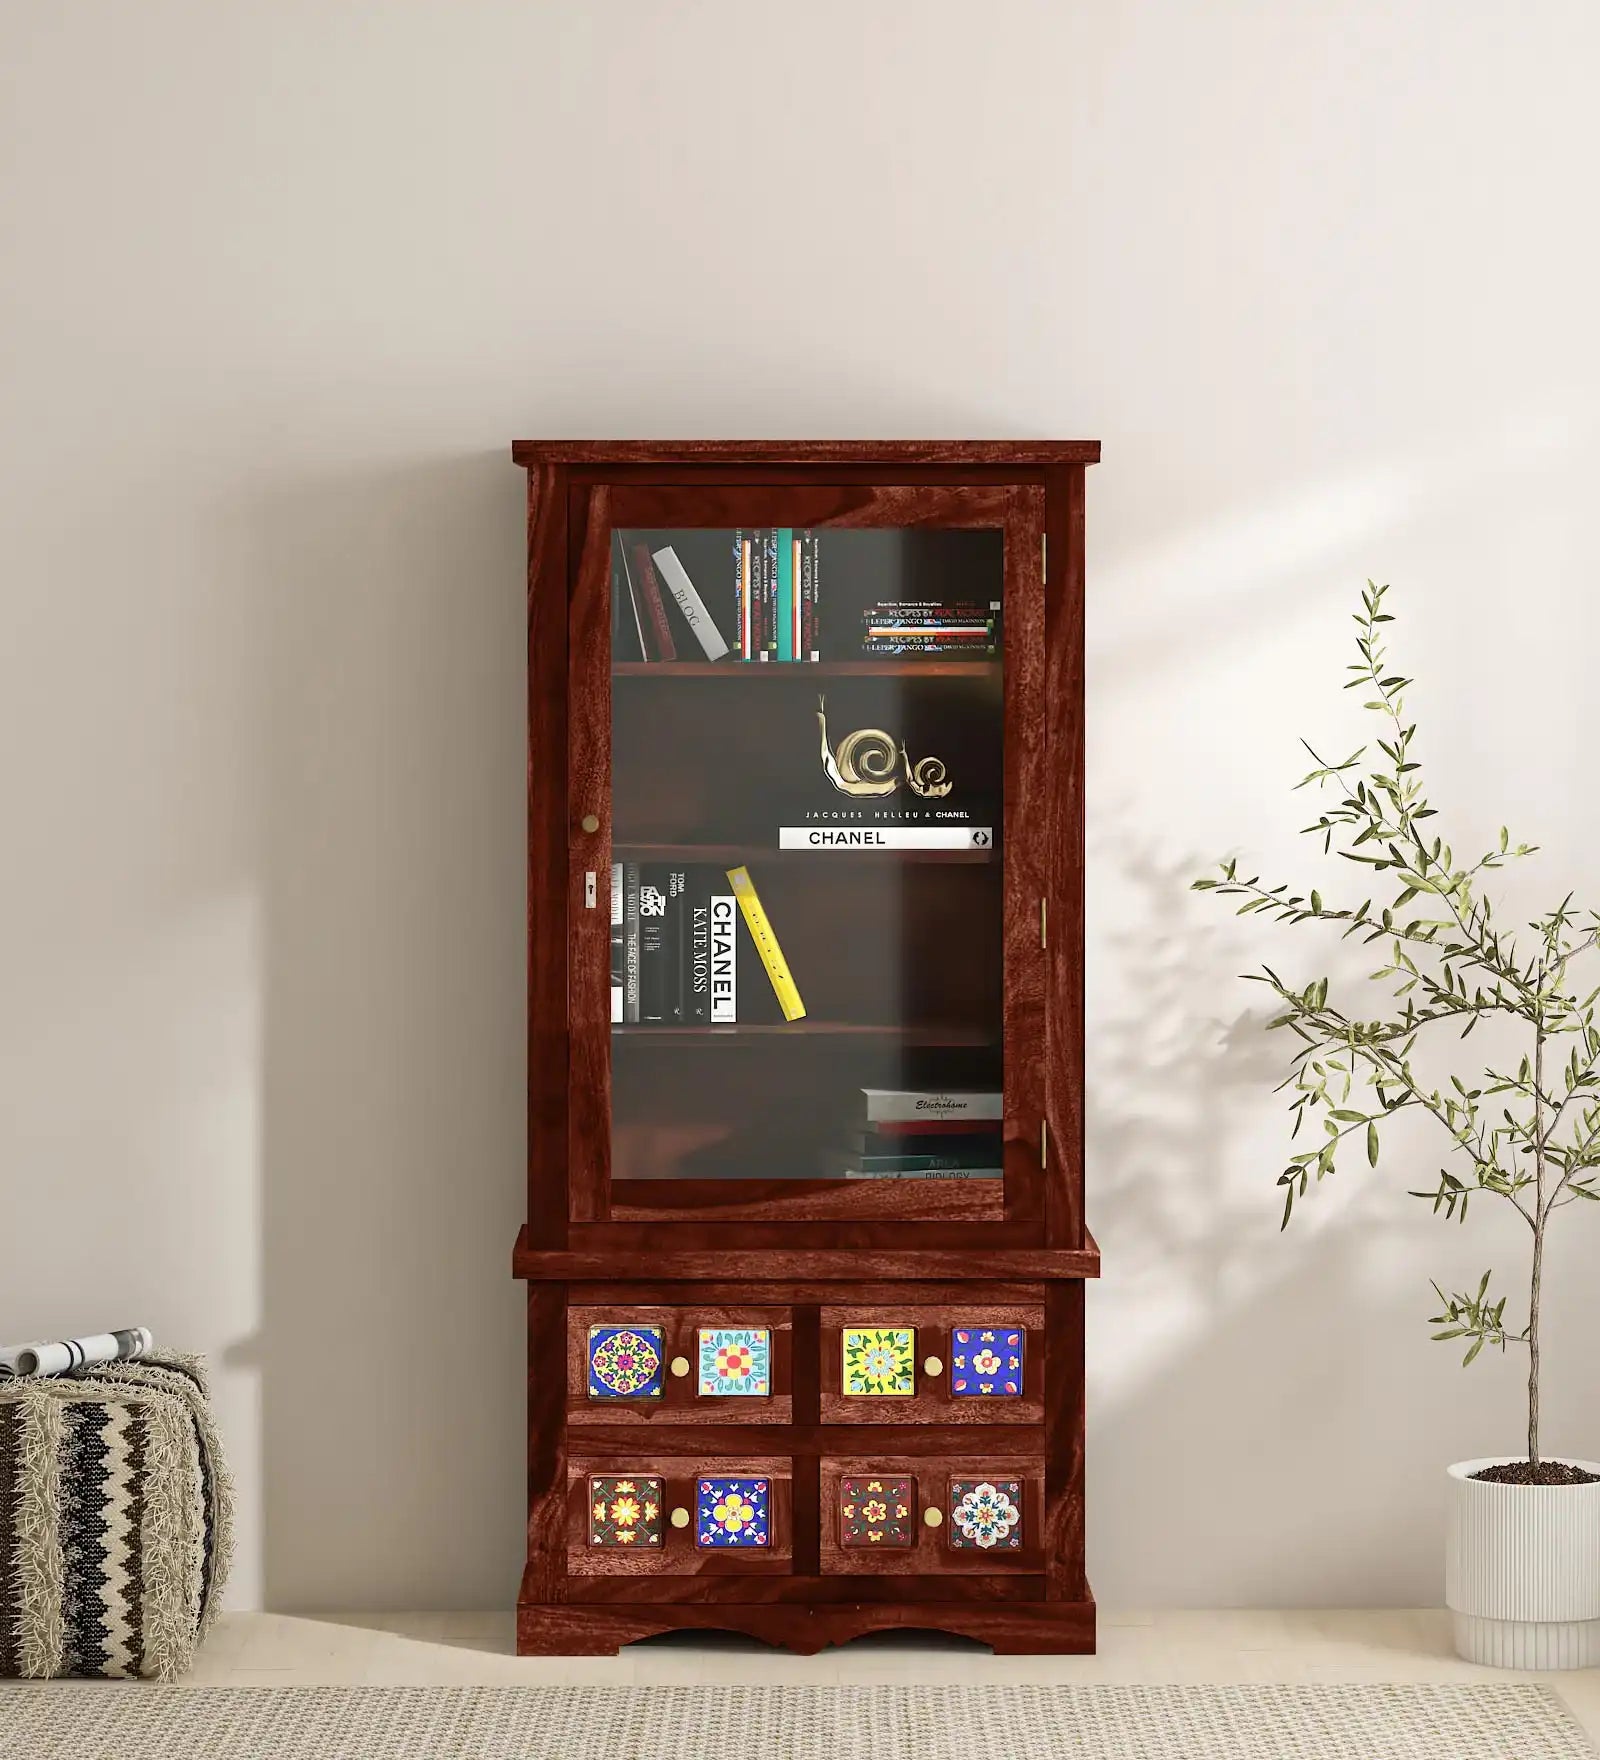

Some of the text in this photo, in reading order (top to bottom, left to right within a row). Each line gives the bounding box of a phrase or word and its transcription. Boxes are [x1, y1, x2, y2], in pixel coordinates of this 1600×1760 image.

[808, 831, 886, 845] CHANEL
[694, 908, 708, 948] KATE
[628, 934, 636, 946] THE
[628, 948, 636, 964] FACE
[713, 902, 732, 1010] CHANEL
[694, 952, 708, 992] MOSS
[628, 975, 636, 1004] FASHION
[916, 1100, 968, 1110] Electrohome
